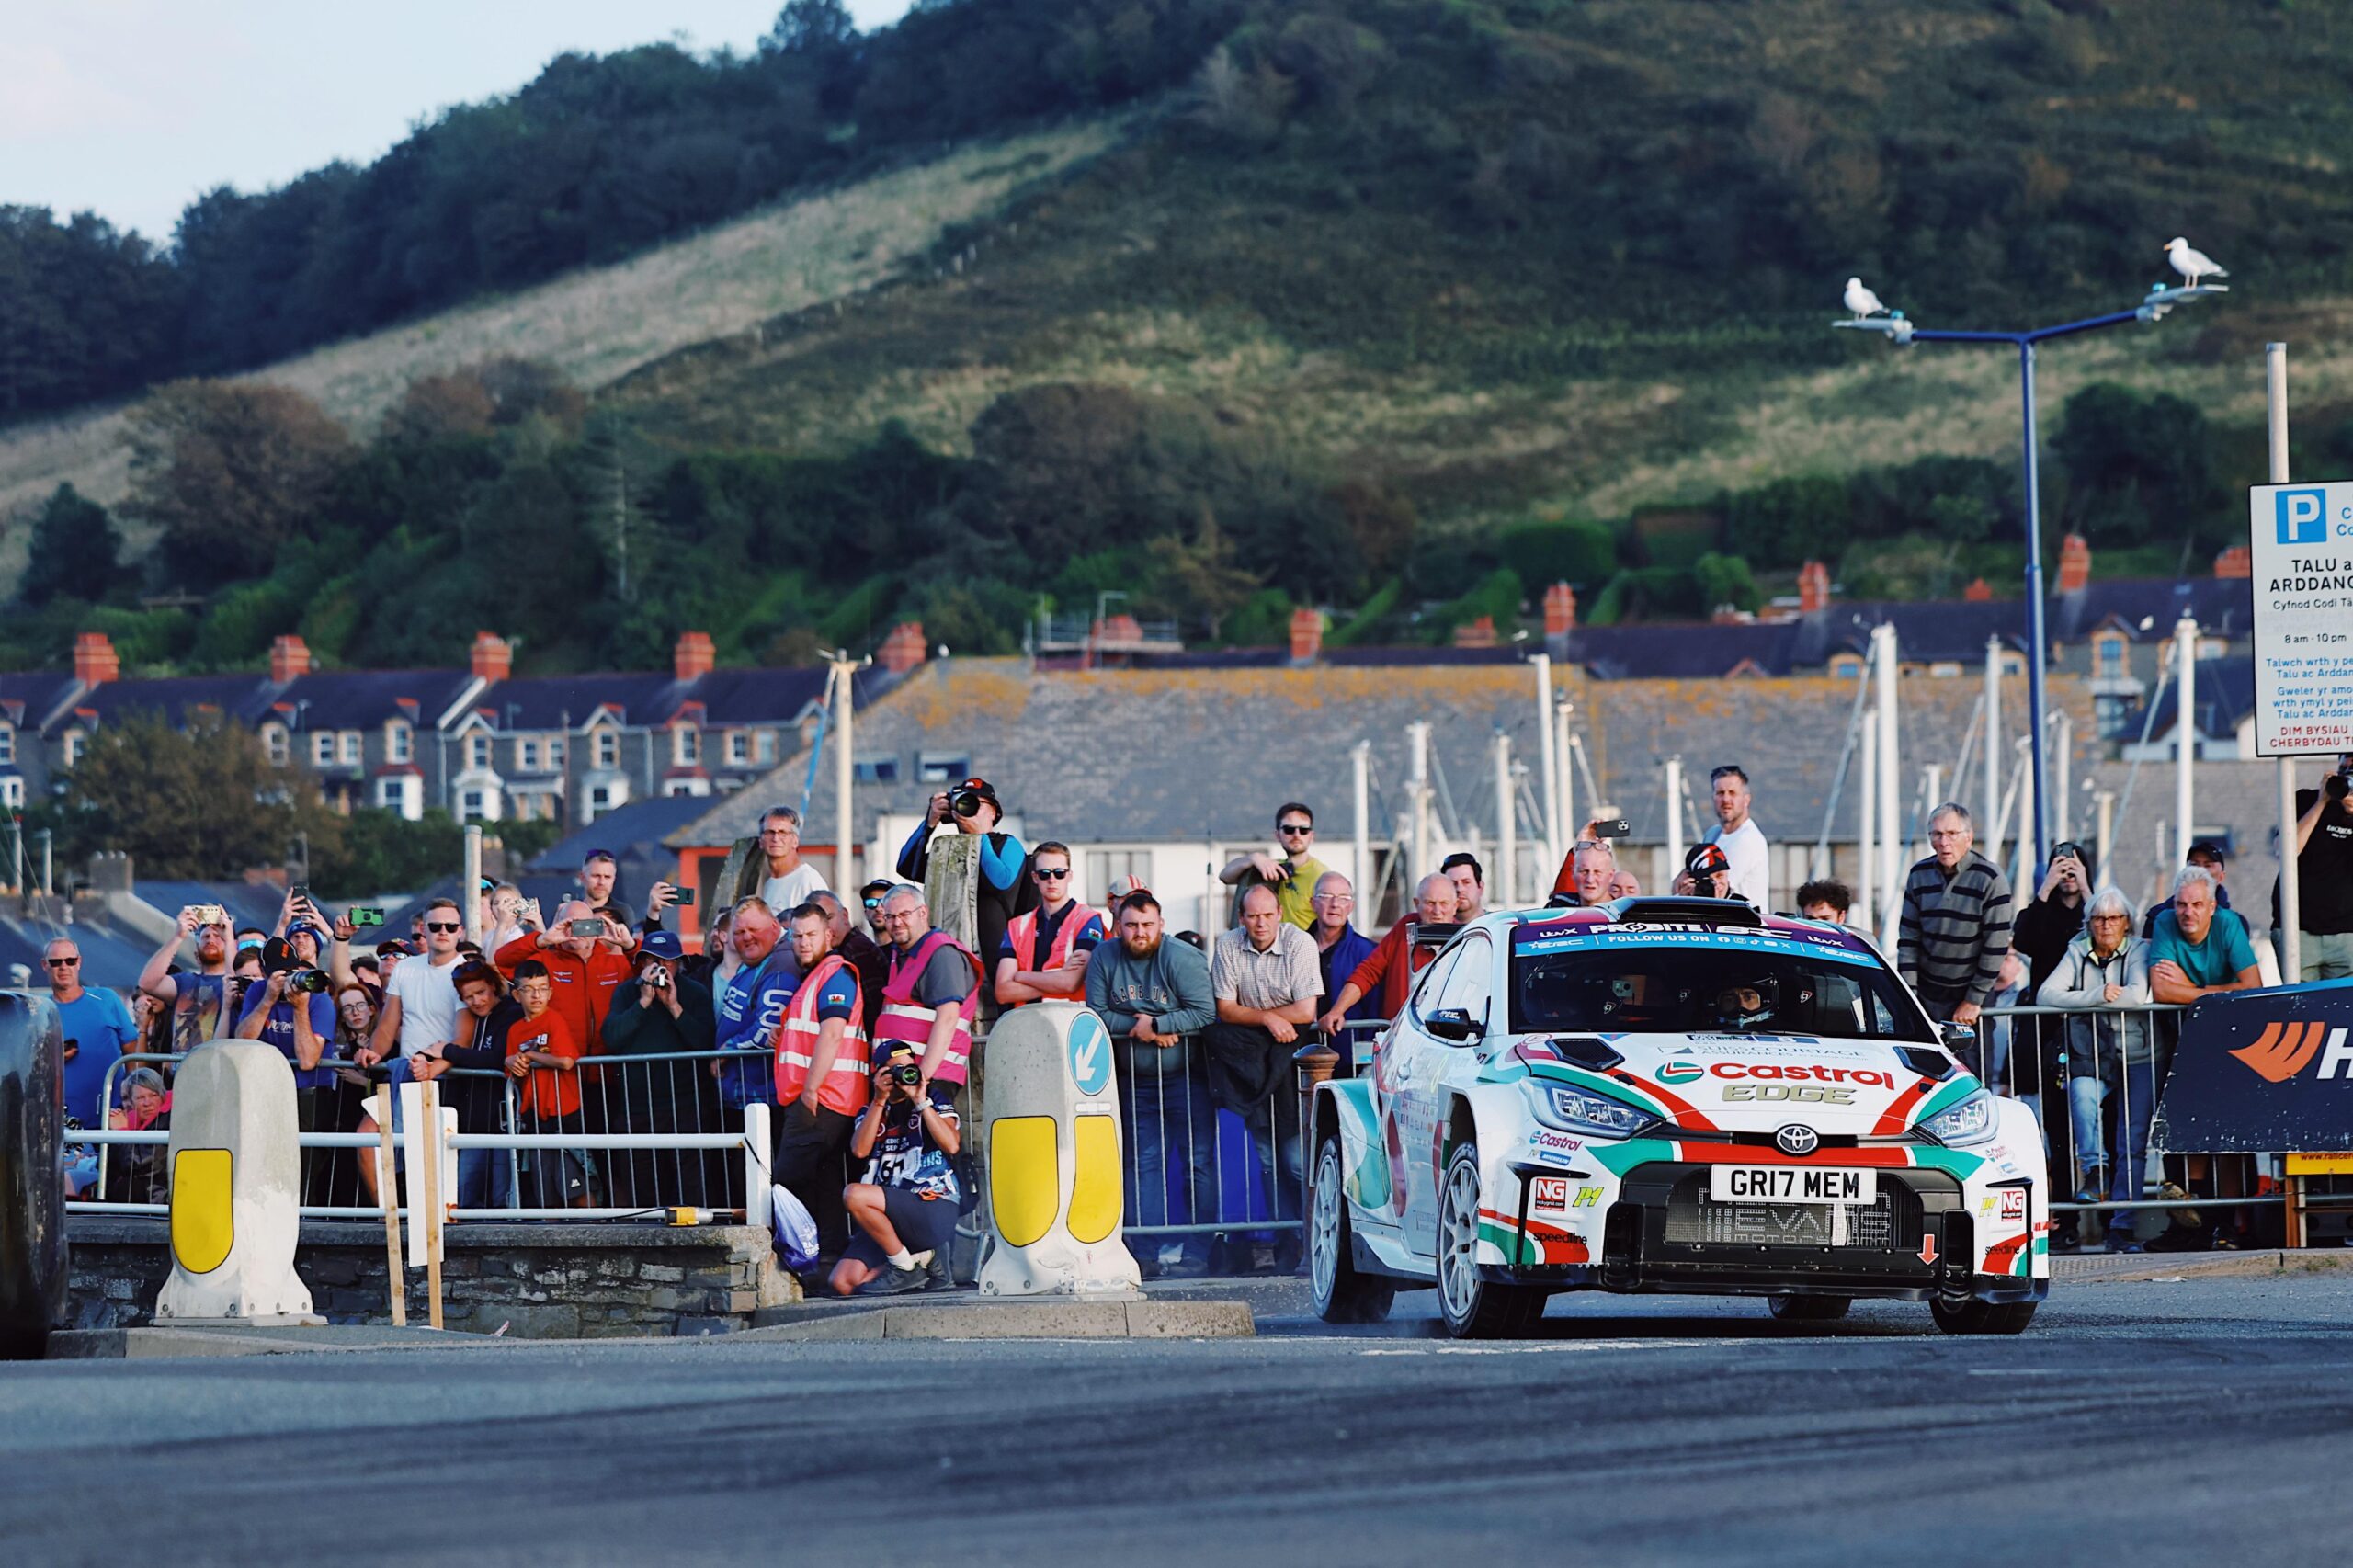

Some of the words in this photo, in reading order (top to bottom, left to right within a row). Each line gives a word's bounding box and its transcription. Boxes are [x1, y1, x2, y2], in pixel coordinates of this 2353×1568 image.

[2288, 494, 2320, 540] P
[2291, 558, 2336, 574] TALU
[2273, 600, 2310, 611] Cyfnod
[2313, 598, 2336, 608] Codi
[2284, 634, 2291, 643] 8
[2317, 633, 2328, 642] 10
[2331, 635, 2347, 643] pm
[2266, 657, 2302, 667] Talwch
[2306, 656, 2330, 665] wrth
[2277, 669, 2299, 679] Talu
[2278, 687, 2313, 696] Gweler
[2318, 687, 2327, 697] yr
[2272, 699, 2297, 708] wrth
[2301, 698, 2325, 709] ymyl
[2278, 710, 2300, 720] Talu
[2280, 726, 2302, 736] DIM
[2306, 725, 2348, 735] BYSIAU
[2270, 737, 2341, 748] CHERBYDAU
[1608, 935, 1664, 943] FOLLOW
[1710, 1062, 1894, 1091] Castrol
[1722, 1084, 1857, 1105] EDGE
[1540, 1132, 1583, 1151] Castrol
[1537, 1180, 1565, 1199] NG
[1804, 1172, 1859, 1199] MEM
[2002, 1192, 2022, 1210] NG
[1533, 1233, 1587, 1244] speedline
